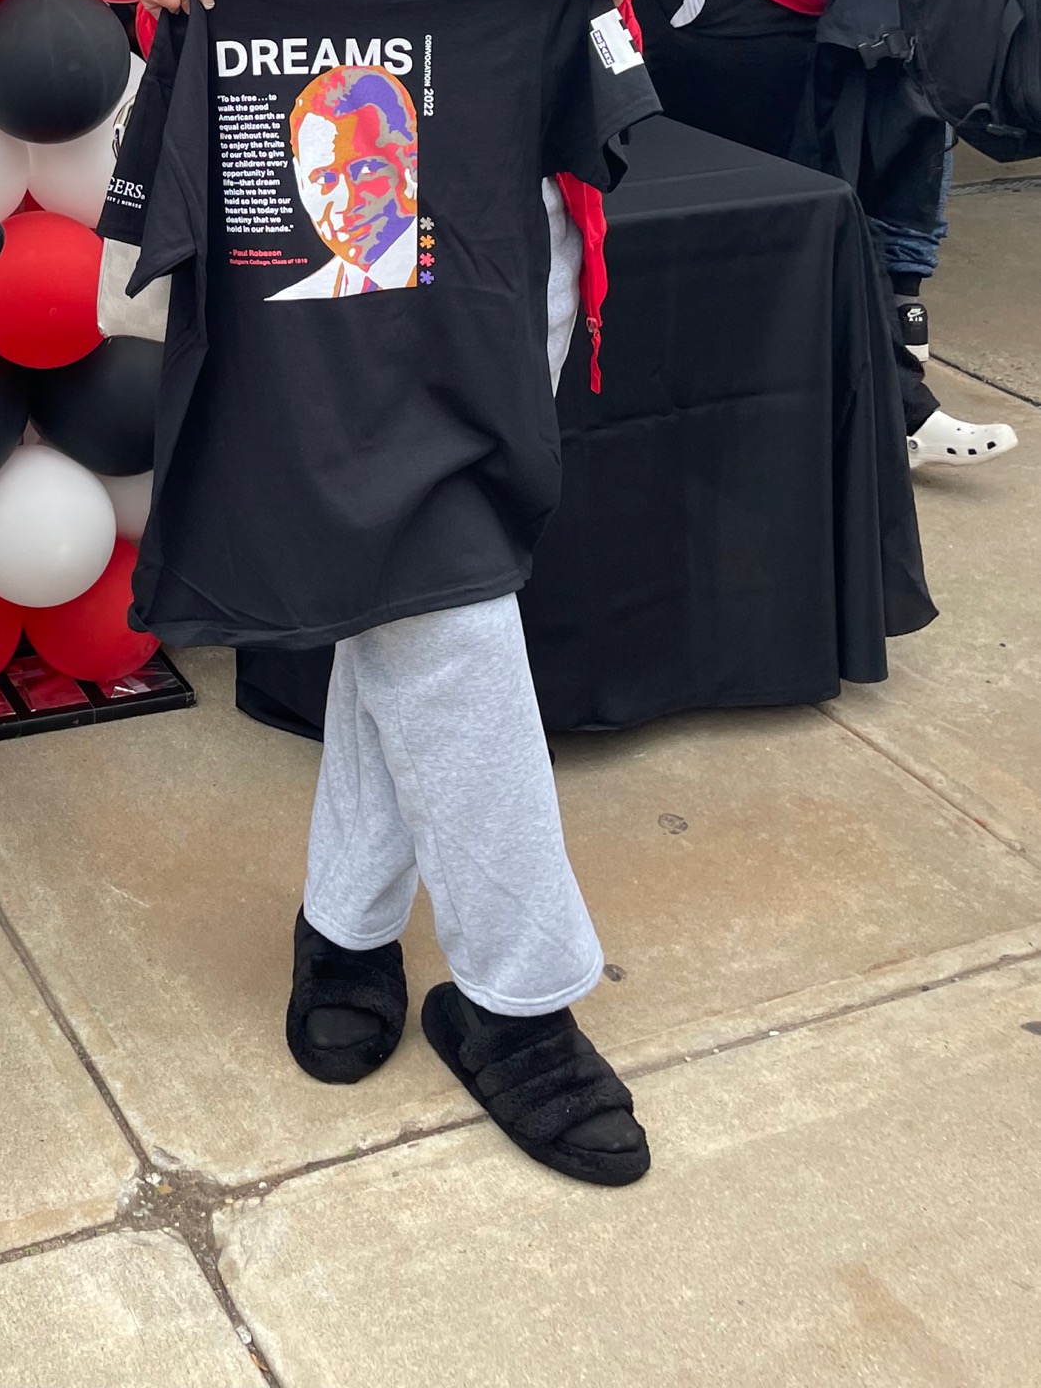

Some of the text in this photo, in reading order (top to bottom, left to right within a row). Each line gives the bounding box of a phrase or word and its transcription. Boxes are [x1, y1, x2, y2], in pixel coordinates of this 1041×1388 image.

[216, 38, 413, 78] DREAMS
[424, 34, 434, 116] CONVOCATION 2022
[249, 103, 269, 112] good
[254, 112, 275, 120] earth
[219, 123, 239, 132] equal
[229, 142, 249, 150] enjoy
[268, 150, 285, 159] give
[223, 170, 265, 178] opportunity
[251, 197, 268, 206] long
[257, 207, 279, 215] today
